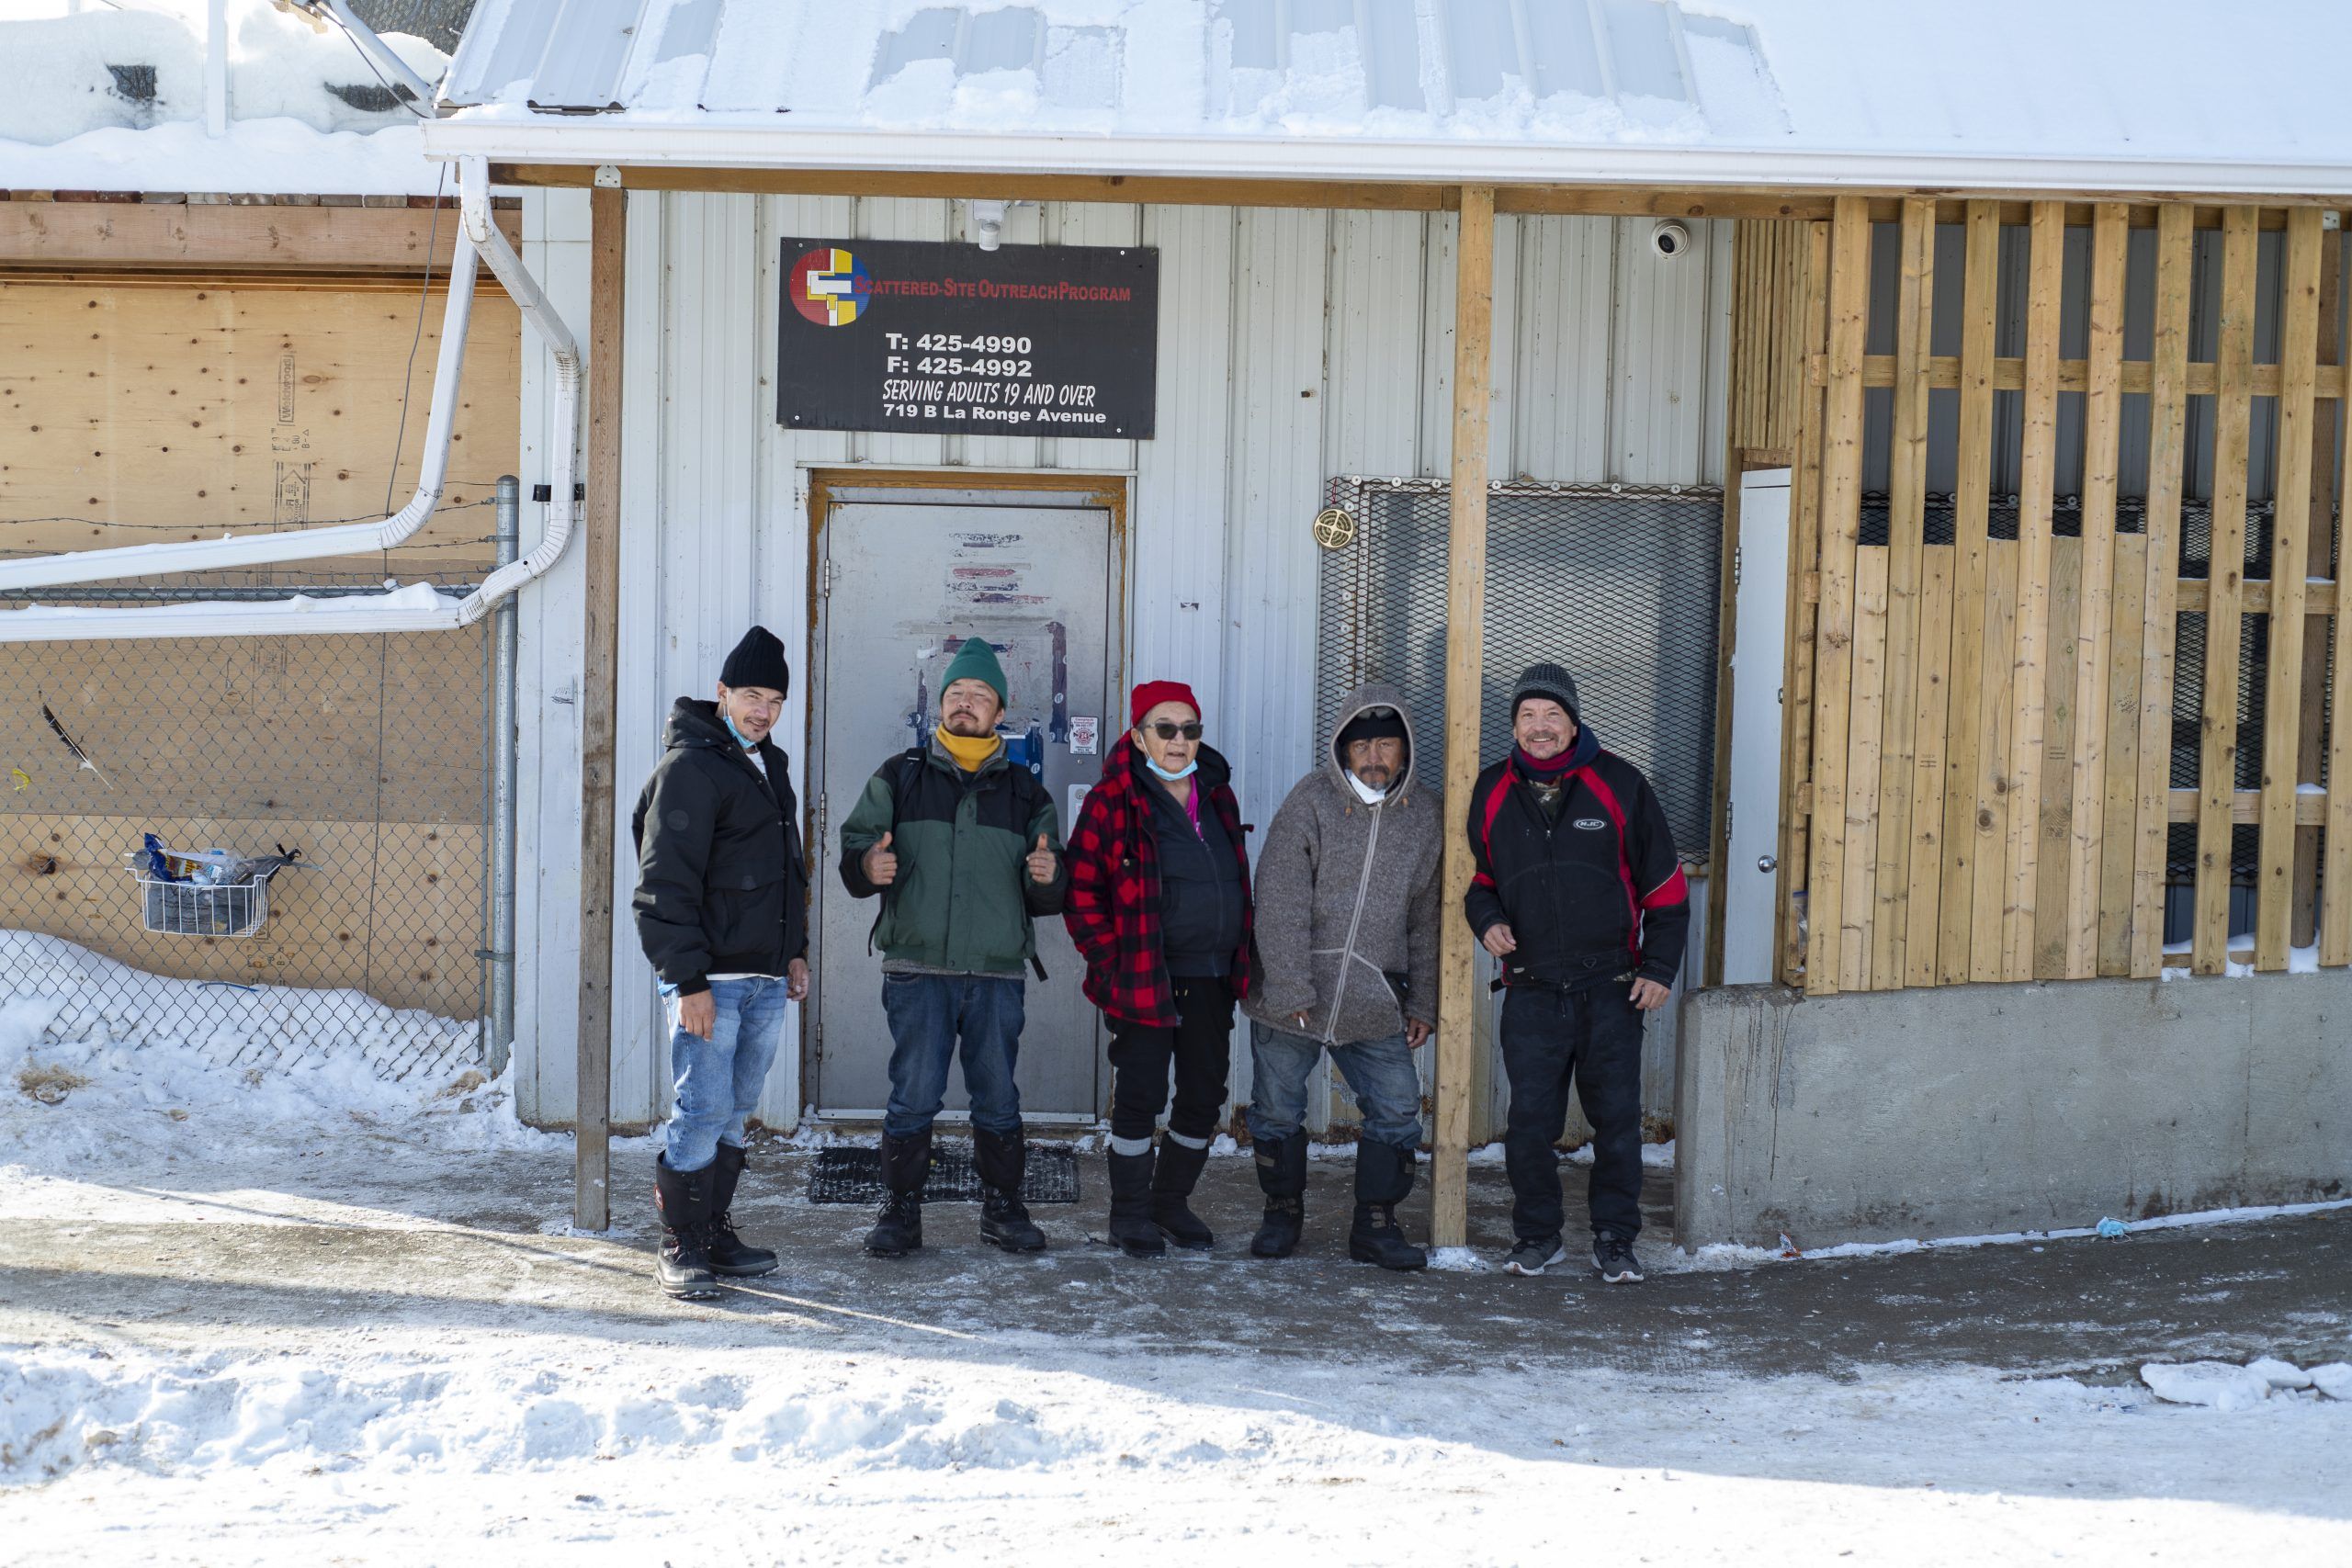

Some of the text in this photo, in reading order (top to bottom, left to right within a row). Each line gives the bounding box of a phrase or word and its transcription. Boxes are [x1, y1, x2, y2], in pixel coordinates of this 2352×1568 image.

[978, 278, 1057, 300] OUTREACH
[1059, 281, 1131, 301] PROGRAM
[886, 333, 1032, 355] T: 425-4990
[887, 355, 1032, 377] F: 425-4992
[882, 378, 1096, 408] SERVING ADULTS 19 AND OVER
[883, 403, 1107, 423] 719 B La Ronge Avenue
